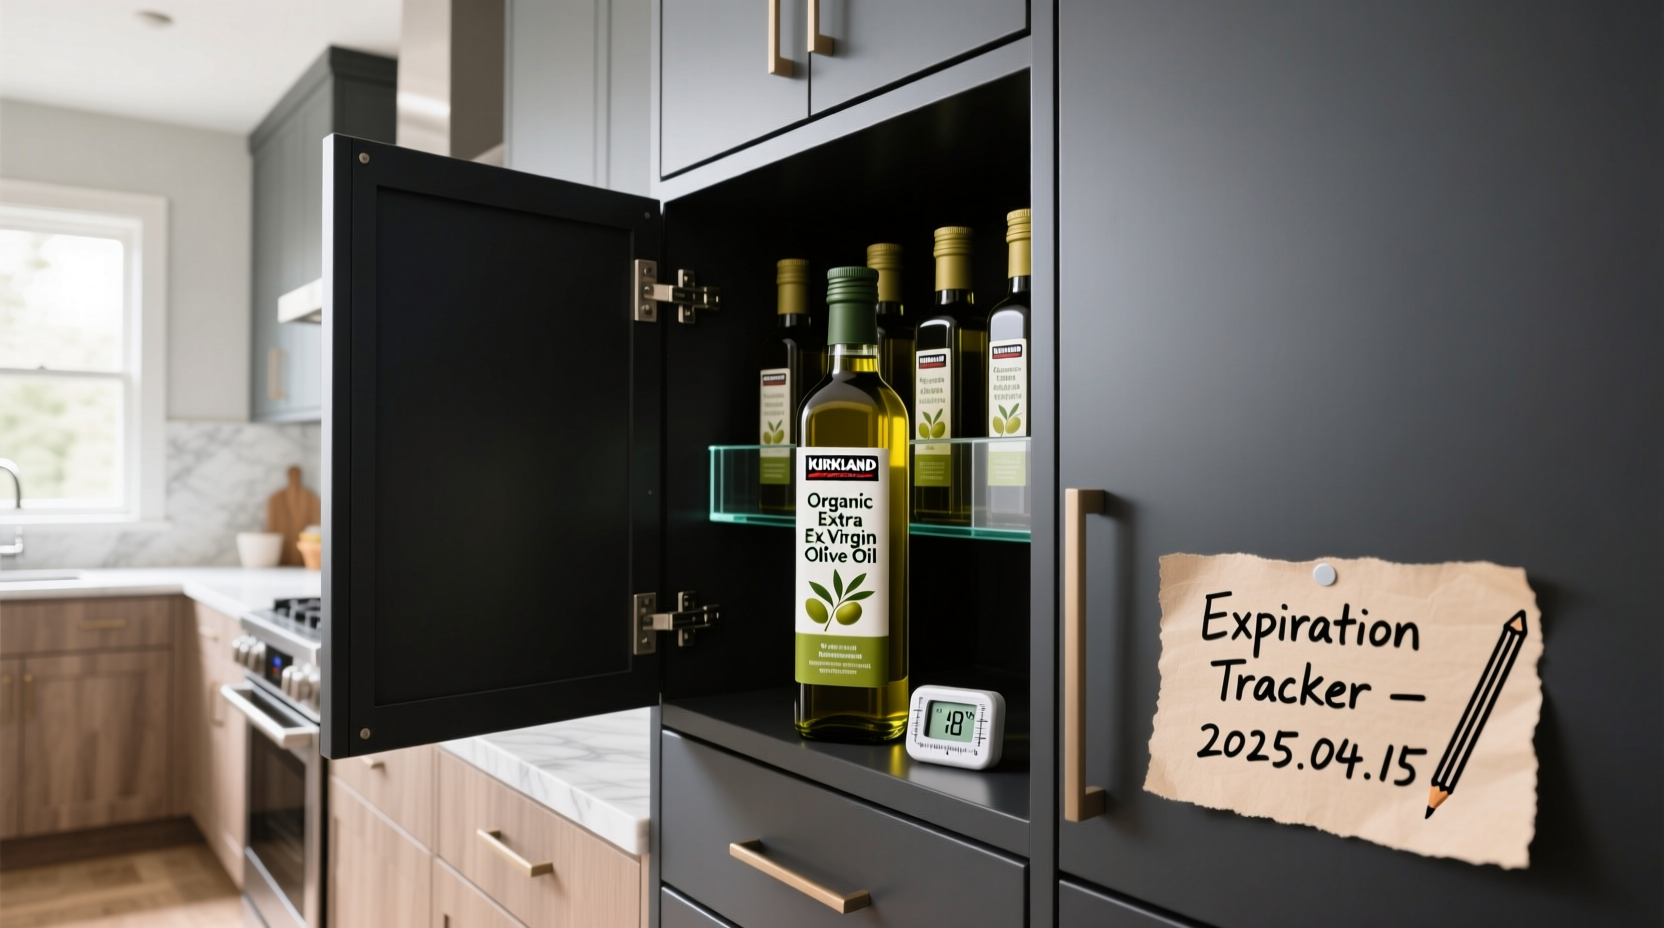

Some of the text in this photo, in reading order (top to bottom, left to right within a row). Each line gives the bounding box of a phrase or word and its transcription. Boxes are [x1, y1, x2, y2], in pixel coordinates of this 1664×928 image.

[808, 457, 877, 471] KIRKLAND
[807, 492, 873, 512] Organic
[818, 511, 863, 527] Extra
[805, 528, 877, 548] Ex Virgin
[805, 546, 877, 563] Olive Oil
[1202, 591, 1420, 658] Expiration
[1210, 658, 1372, 710] Tracker
[1197, 723, 1428, 786] 2025.04.15
